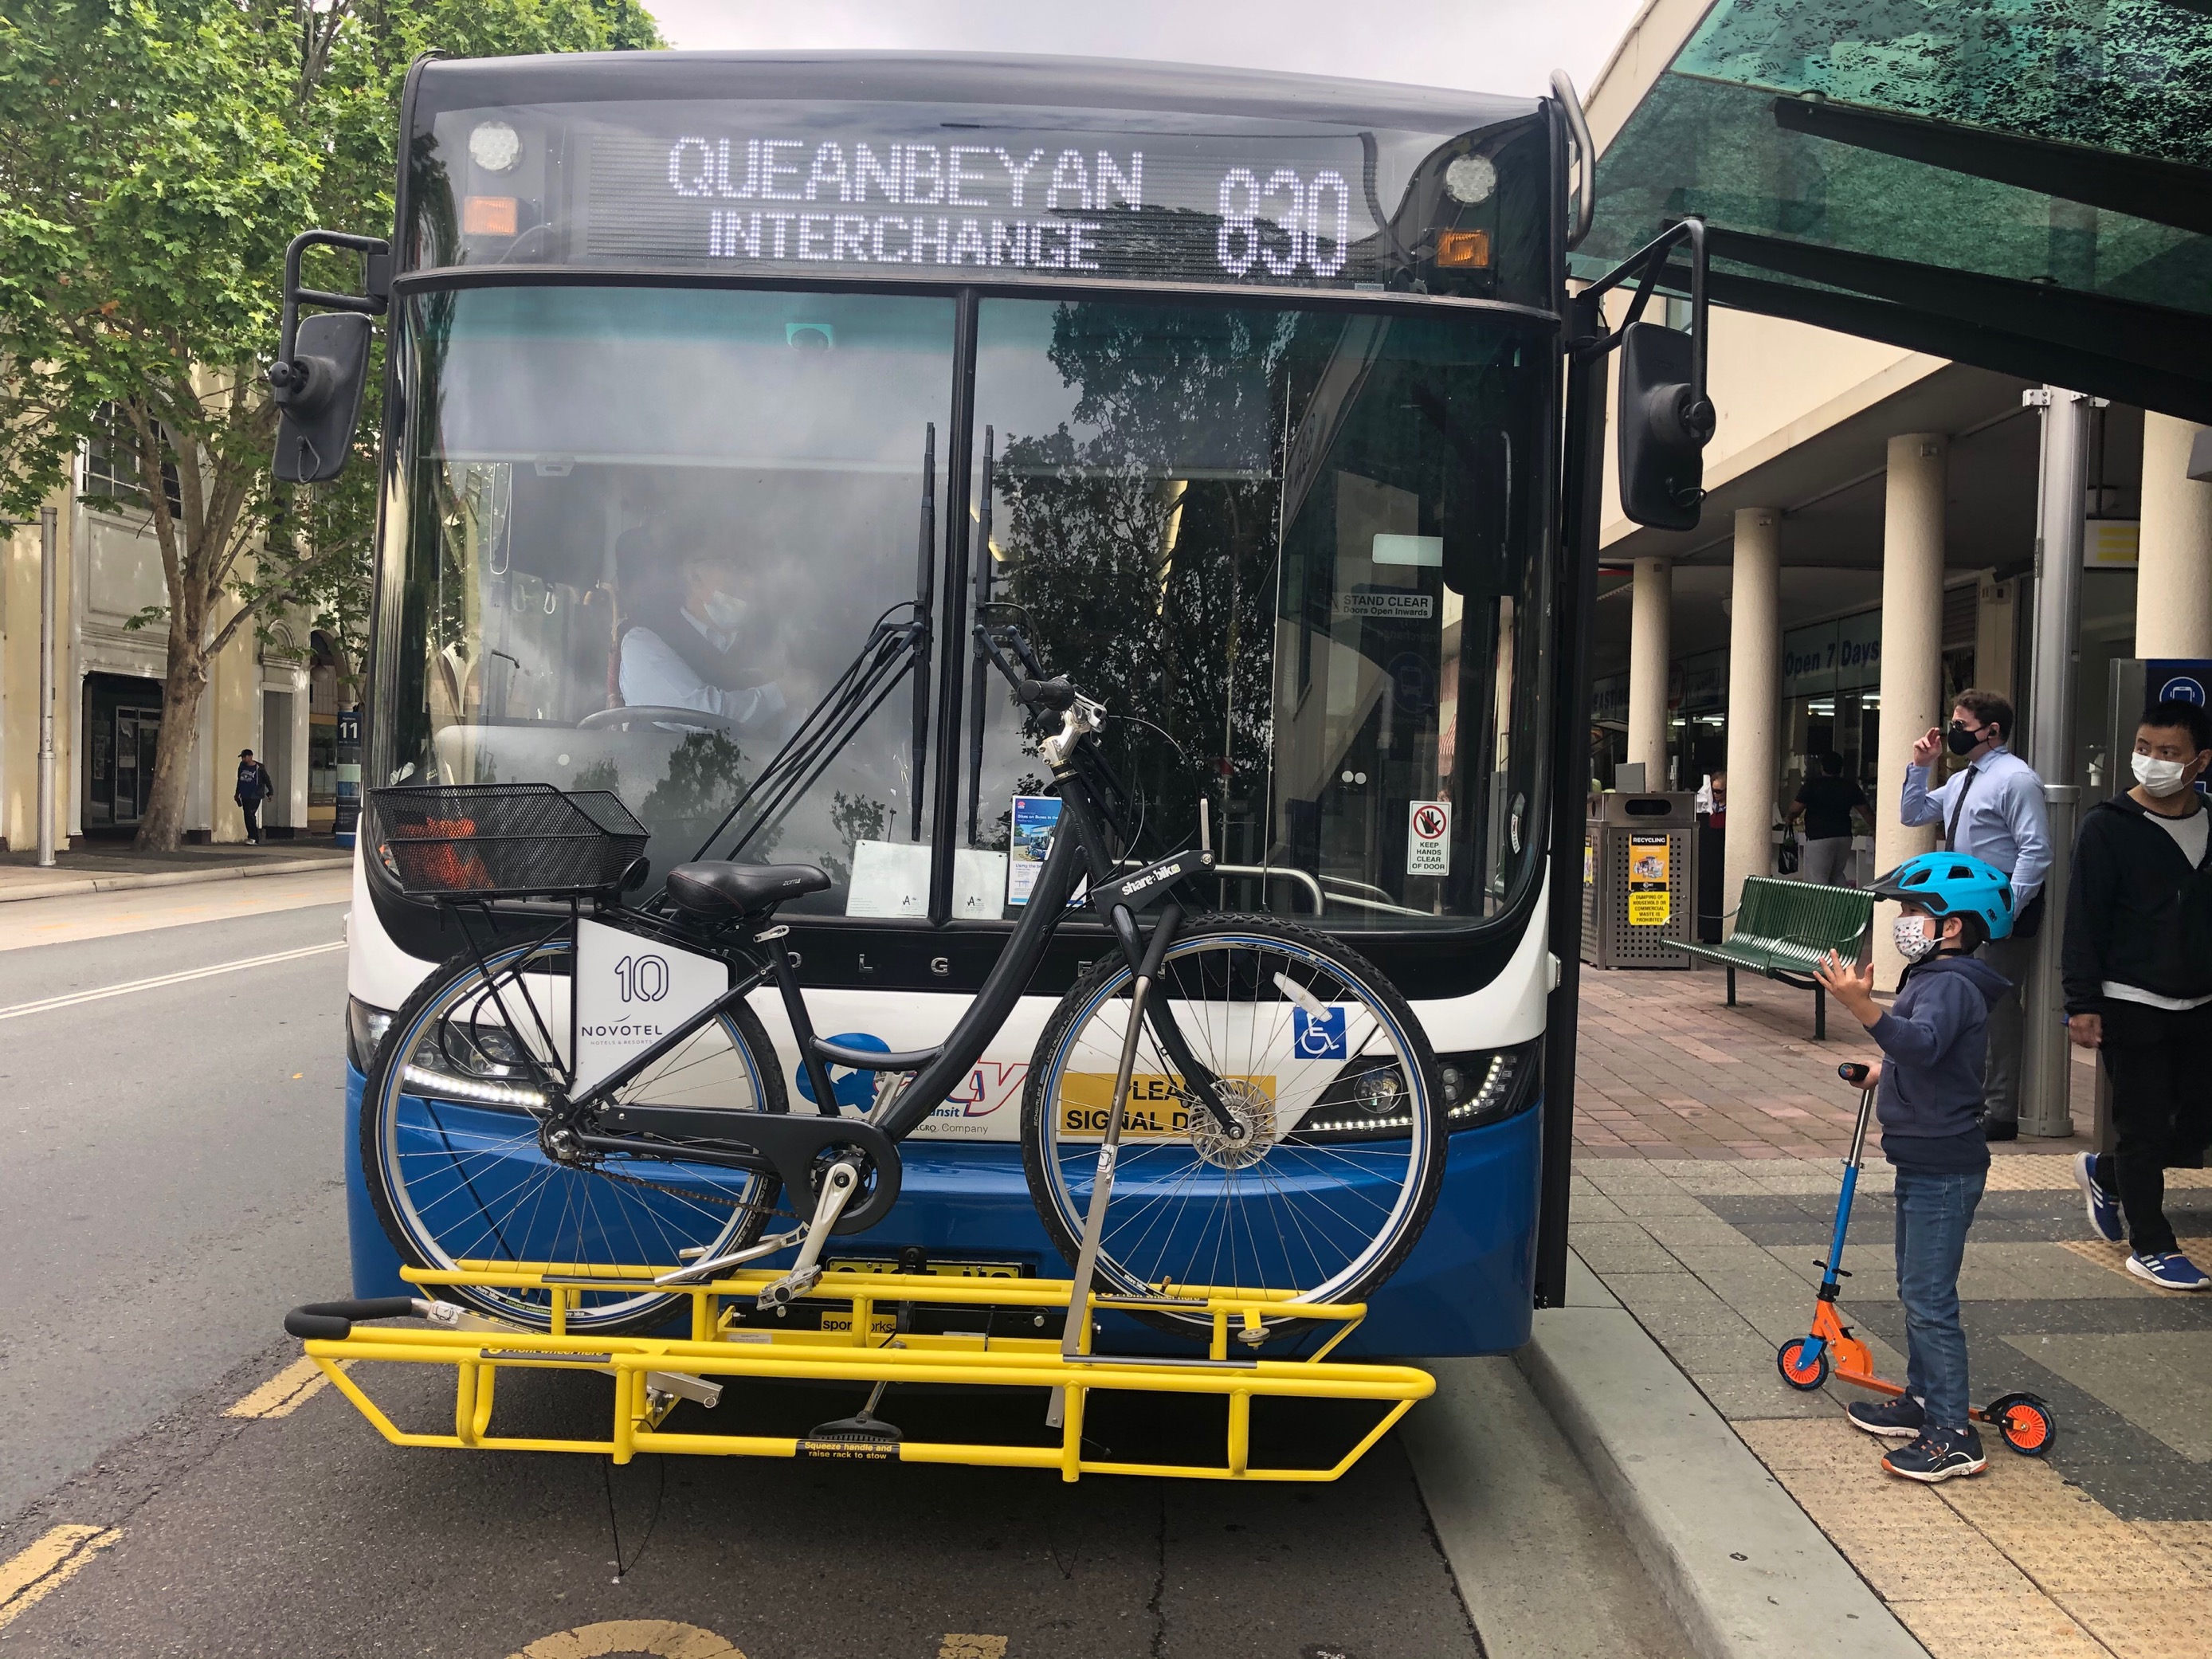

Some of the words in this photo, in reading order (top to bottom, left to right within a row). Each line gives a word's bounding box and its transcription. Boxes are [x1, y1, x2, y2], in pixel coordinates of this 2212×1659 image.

[668, 135, 1143, 211] QUEANBEYAN
[1217, 167, 1349, 276] 830
[708, 210, 1101, 270] INTERCHANGE
[1343, 594, 1384, 606] STAND
[1388, 596, 1428, 607] CLEAR
[1371, 607, 1393, 616] Open
[1785, 651, 1820, 680] Open
[1827, 643, 1836, 669] 7
[1841, 639, 1880, 668] Days
[340, 722, 358, 739] 11
[614, 955, 669, 1002] 10
[582, 1025, 662, 1036] NOVOTEL
[1033, 1086, 1042, 1127] SCHWALBE
[941, 1123, 988, 1135] Company
[804, 1441, 841, 1450] Squeeze
